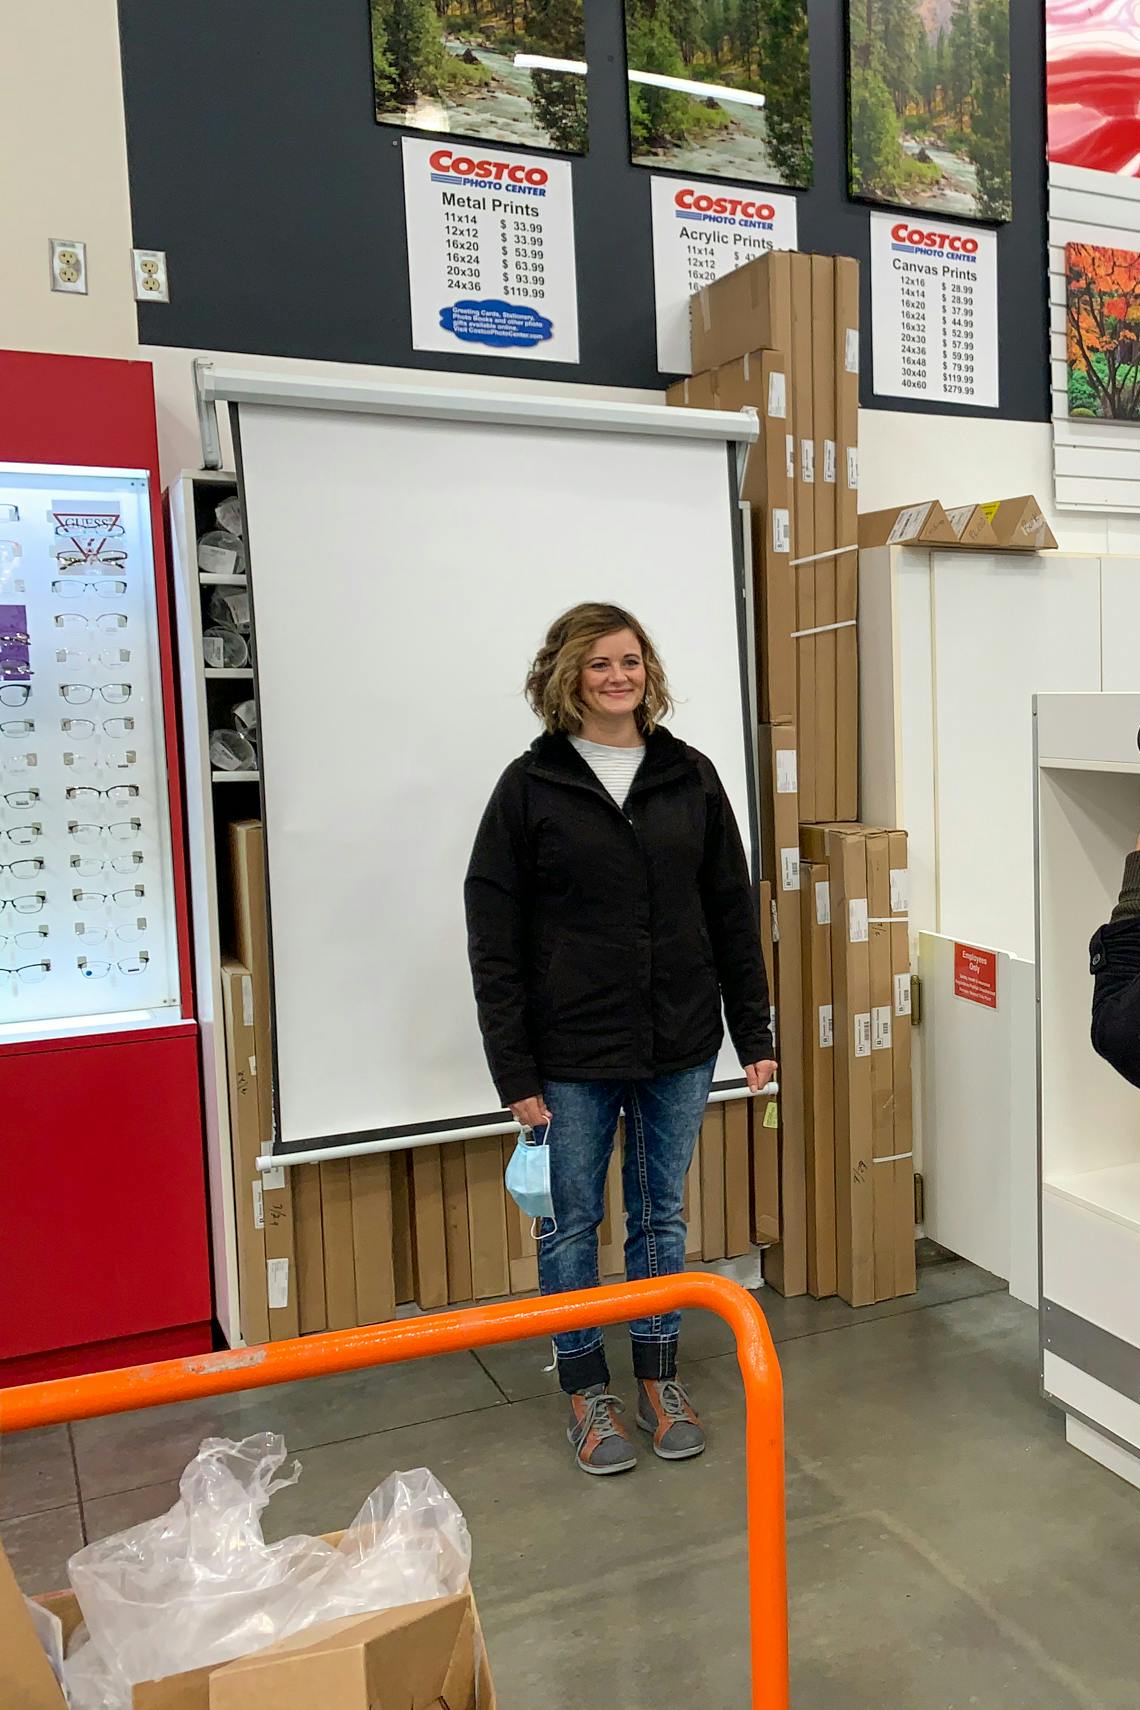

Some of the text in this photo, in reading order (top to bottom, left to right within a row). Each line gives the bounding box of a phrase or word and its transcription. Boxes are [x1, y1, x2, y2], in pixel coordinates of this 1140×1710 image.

[429, 150, 548, 185] COSTCO
[462, 178, 546, 197] PHOTO CENTER
[442, 192, 539, 217] Metal Prints
[675, 188, 775, 220] COSTCO
[444, 212, 543, 233] 11x14 33.99
[702, 214, 773, 230] PHOTO CENTER
[445, 226, 543, 246] 12x12 33.99
[680, 226, 773, 249] Acrylic Prints
[891, 224, 978, 253] COSTCO
[446, 239, 544, 259] 16x20 53.99
[688, 245, 714, 256] 11x14
[915, 247, 976, 263] PHOTO CENTER
[447, 252, 544, 272] 16x24 63.99
[688, 258, 715, 268] 12x12
[893, 258, 977, 281] Canvas Prints
[447, 266, 544, 286] 20x30 93.99
[688, 270, 716, 280] 16x20
[448, 279, 544, 298] 24x36 $119.99
[901, 287, 925, 298] 14x14
[901, 299, 973, 317] 16x20 37.99
[901, 311, 925, 321] 16x24
[901, 322, 926, 333] 16x32
[901, 333, 926, 344] 20x30
[902, 368, 926, 378] 30x40
[902, 380, 926, 389] 40x60
[65, 517, 109, 528] GUESS
